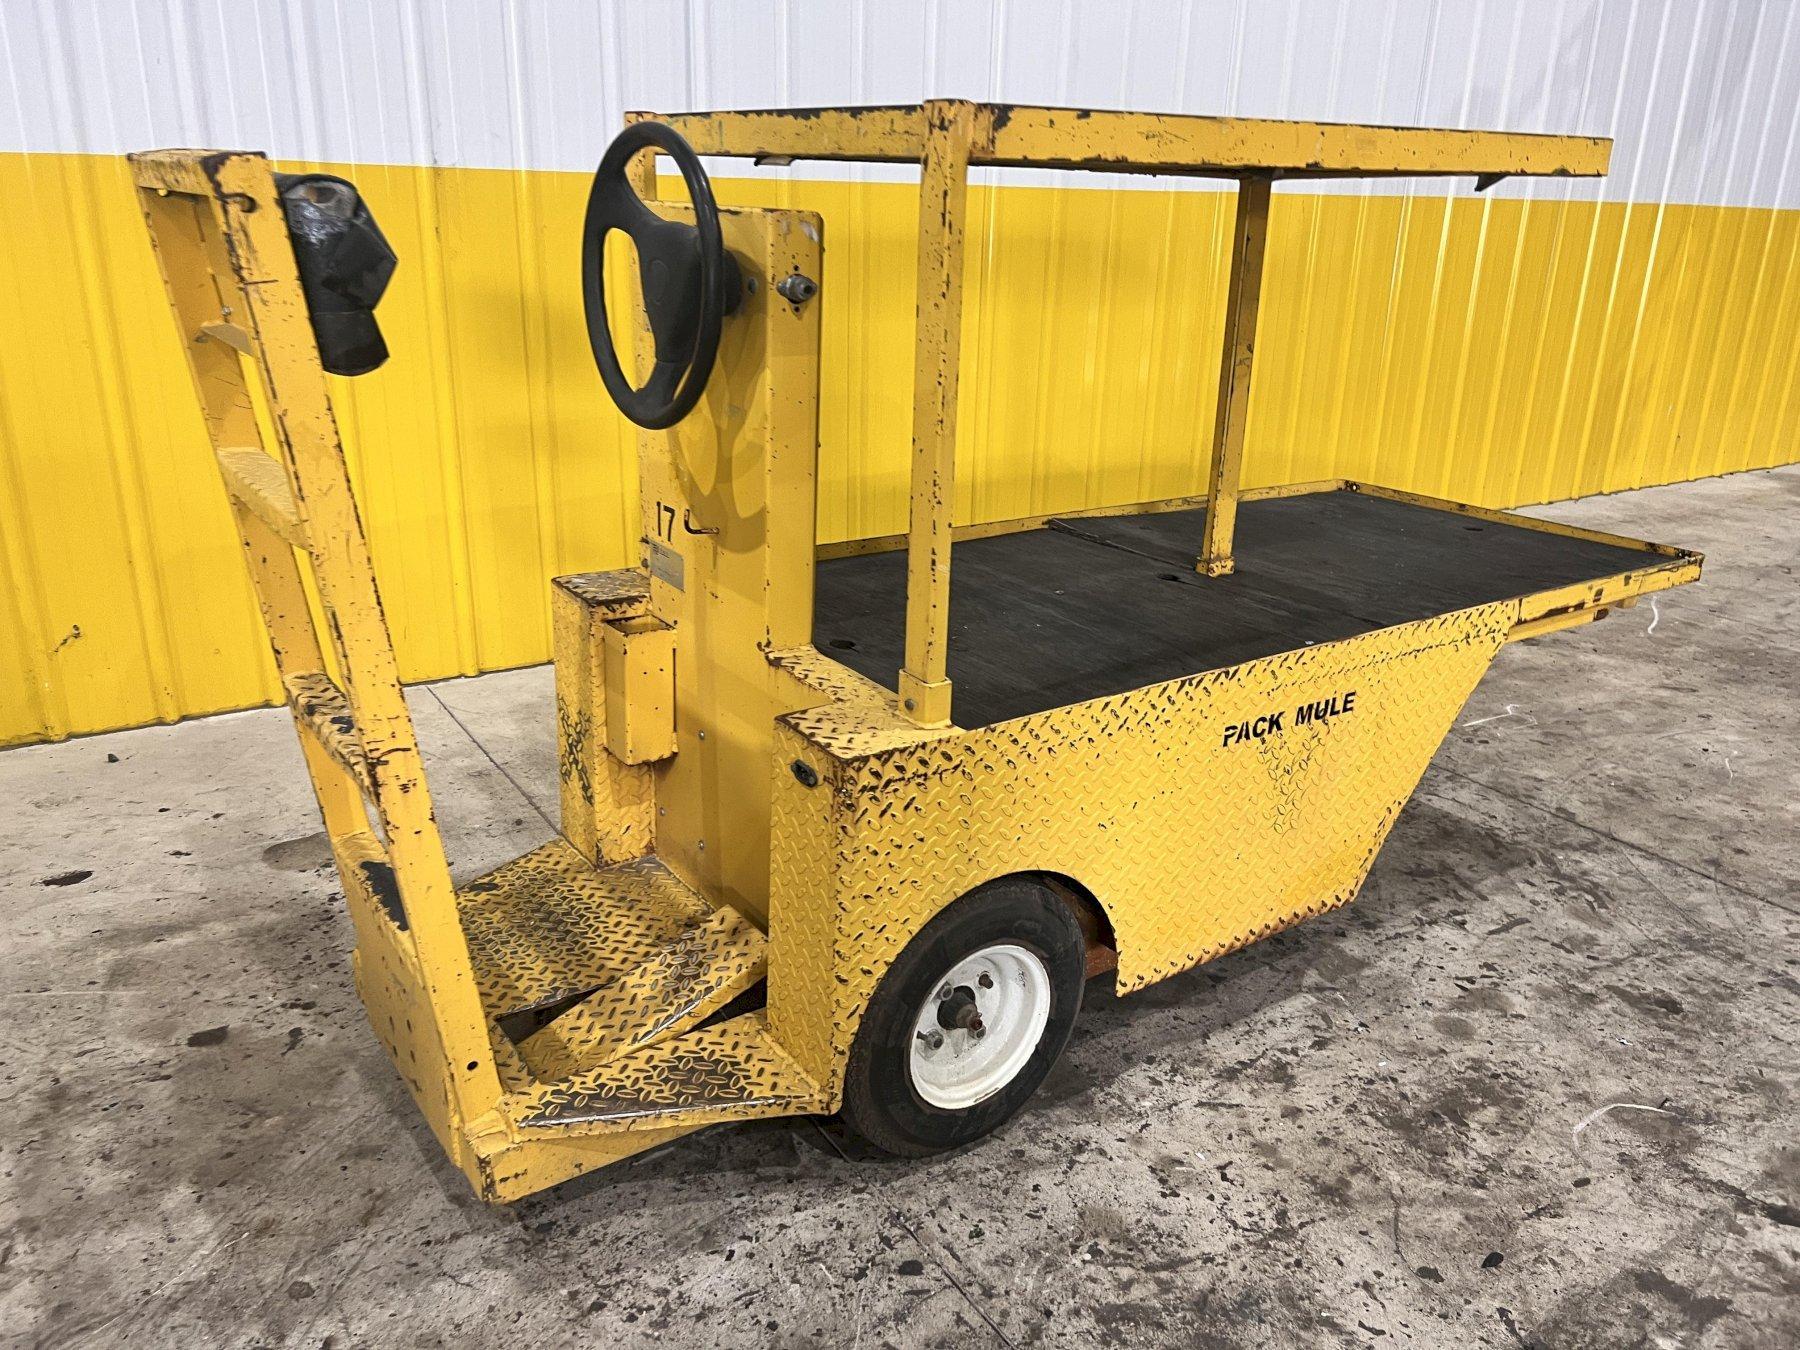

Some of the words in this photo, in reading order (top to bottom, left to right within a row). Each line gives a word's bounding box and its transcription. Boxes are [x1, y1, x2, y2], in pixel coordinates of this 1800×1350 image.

[656, 501, 675, 542] 17
[1223, 711, 1286, 747] PACK
[1295, 692, 1356, 726] MULE
